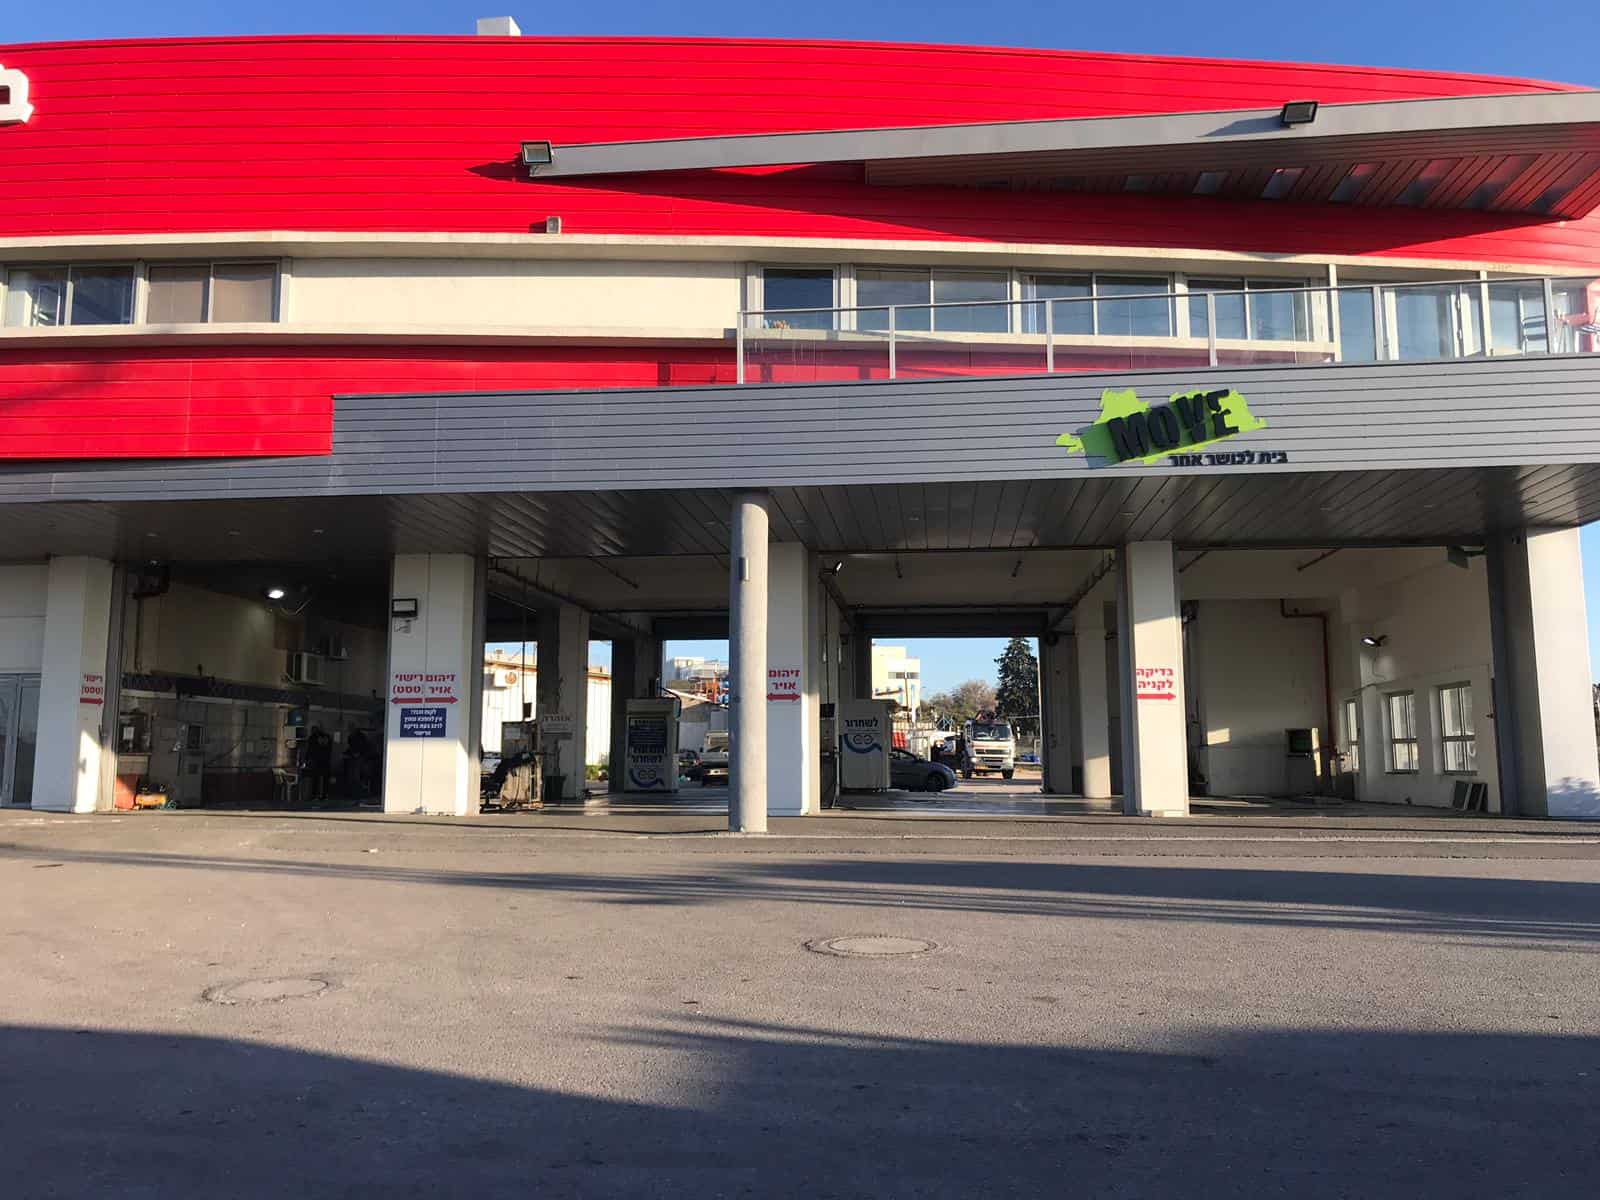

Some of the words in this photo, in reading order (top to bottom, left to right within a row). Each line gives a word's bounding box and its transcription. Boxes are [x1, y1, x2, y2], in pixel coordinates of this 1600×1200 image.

[1106, 388, 1240, 462] MOVE
[1167, 454, 1203, 467] אחר
[1205, 449, 1256, 467] לכושר
[1259, 450, 1289, 465] בית
[394, 673, 424, 682] רישוי
[425, 673, 457, 682] זיהום
[768, 669, 800, 678] זיהום
[1136, 668, 1174, 678] בדיקה
[392, 684, 424, 695] (טסט)
[1138, 679, 1174, 691] לקניה
[844, 715, 879, 728] לשחרור
